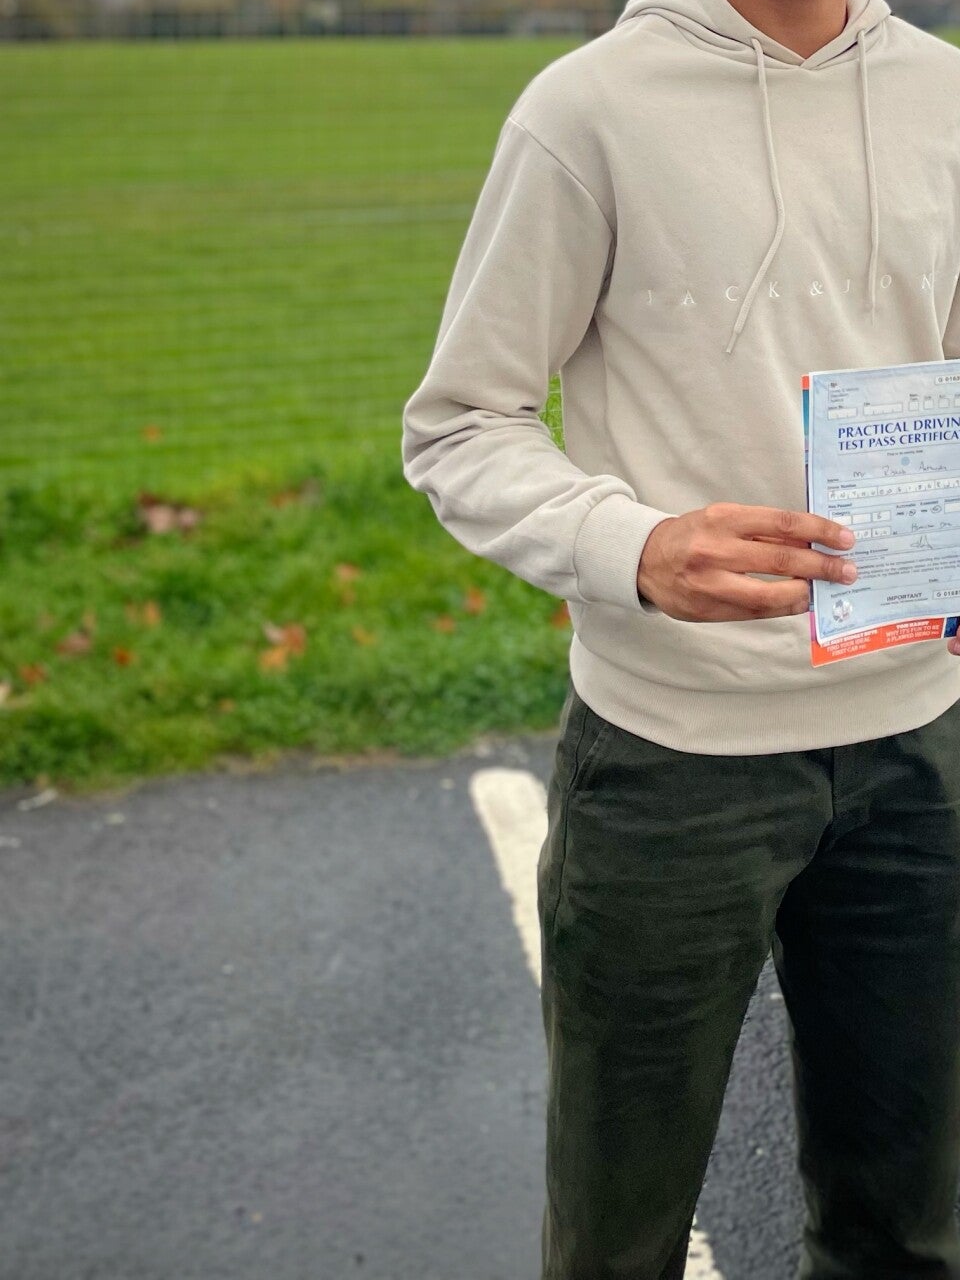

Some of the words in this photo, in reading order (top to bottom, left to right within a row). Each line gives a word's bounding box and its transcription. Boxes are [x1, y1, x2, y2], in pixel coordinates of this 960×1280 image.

[647, 281, 780, 306] JACK
[809, 280, 825, 296] &
[838, 421, 909, 439] PRACTICAL
[838, 439, 864, 452] TEST
[868, 435, 896, 448] PASS
[887, 592, 922, 603] IMPORTANT
